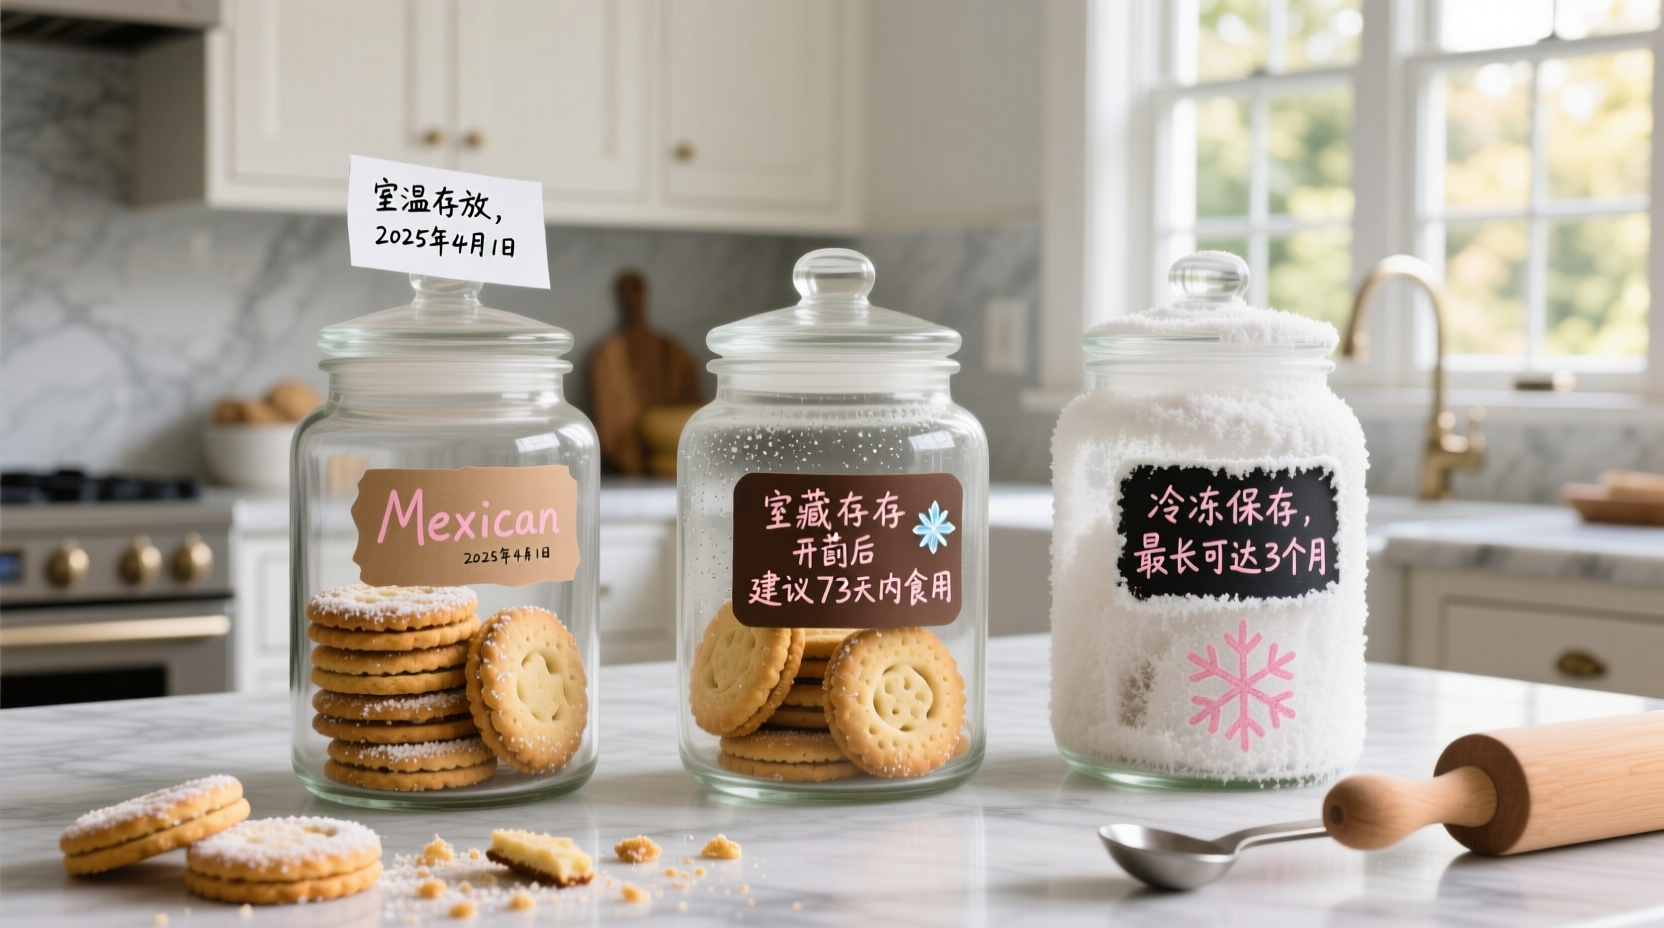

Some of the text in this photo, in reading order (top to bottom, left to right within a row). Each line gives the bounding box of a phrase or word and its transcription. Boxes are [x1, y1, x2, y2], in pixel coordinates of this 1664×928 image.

[374, 177, 502, 225] 室温存放，
[375, 226, 515, 258] 2025年4月1日
[377, 488, 560, 546] Mexican
[764, 487, 906, 531] 室藏存存
[1147, 484, 1311, 527] 冷冻保存，
[463, 546, 550, 565] 2025年4月1日
[1133, 532, 1326, 580] 最长可达3个月
[748, 567, 952, 607] 建议73天内食用
